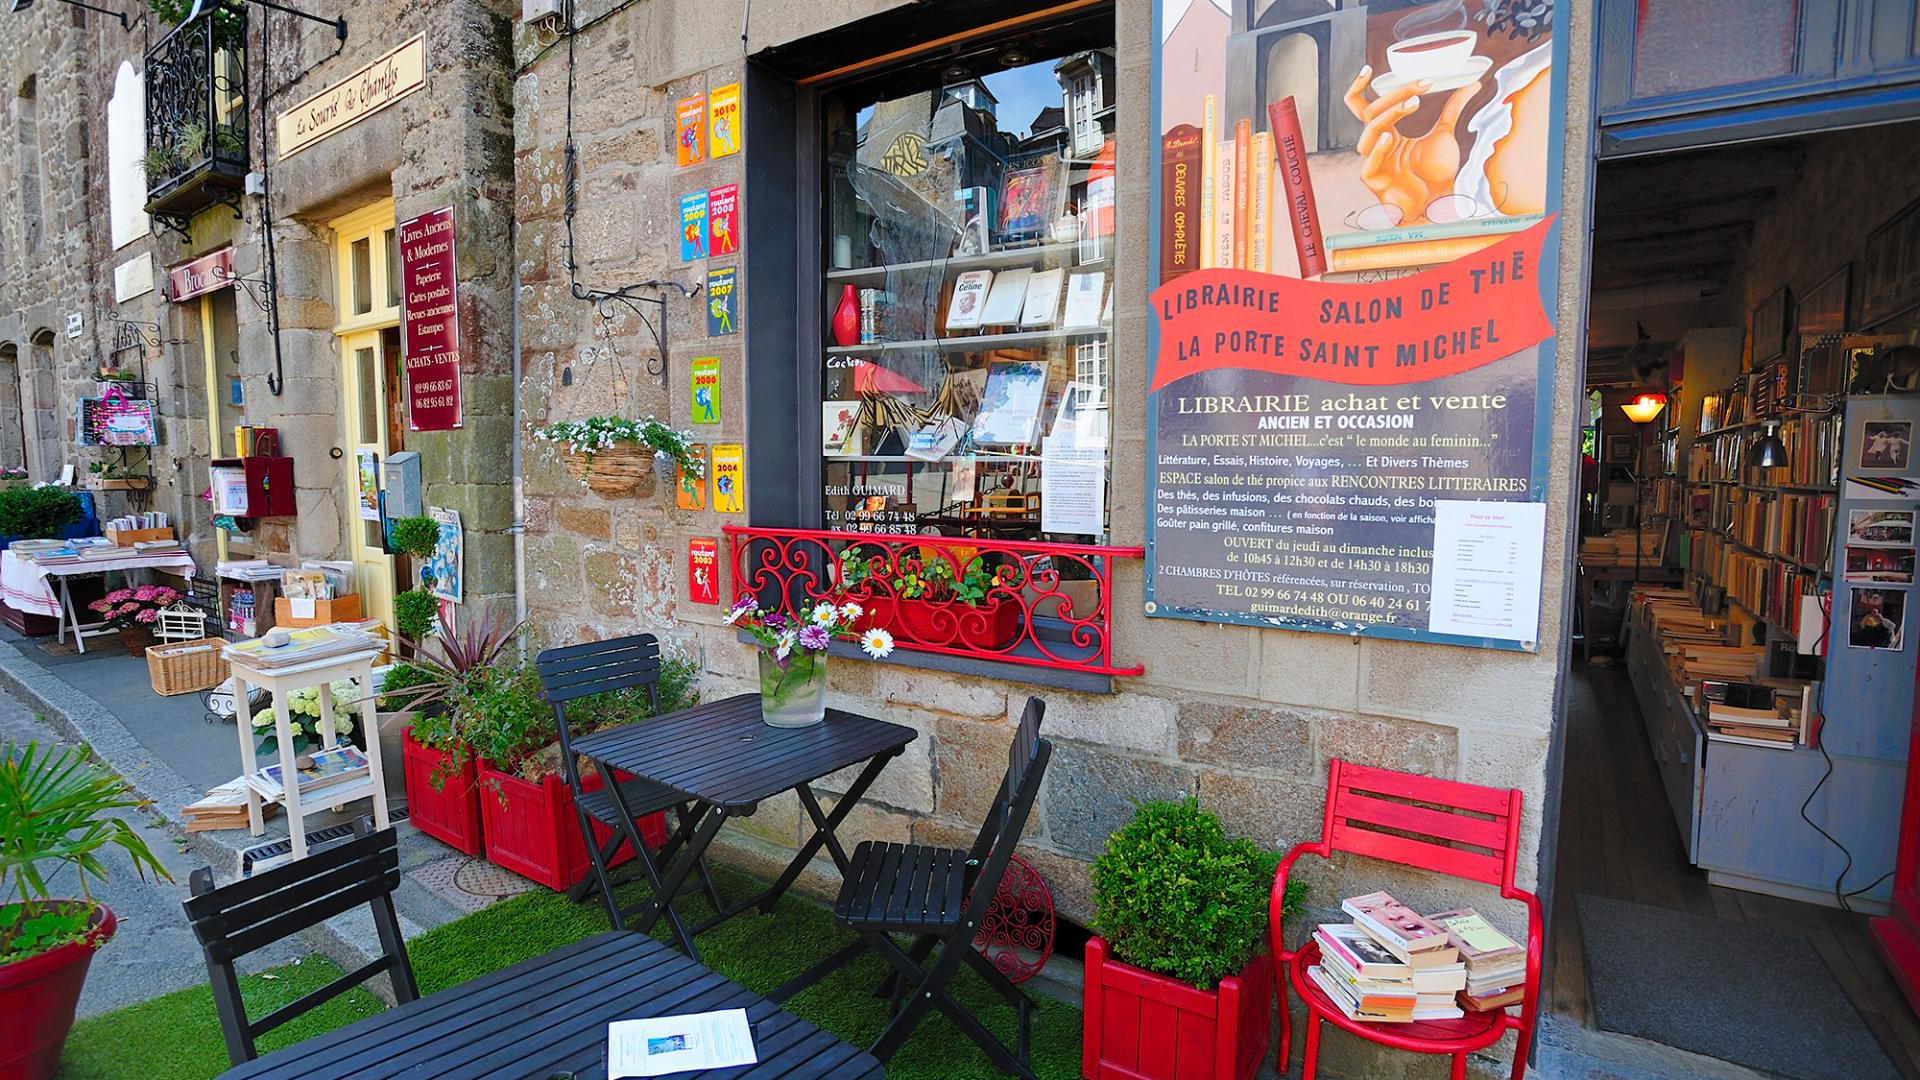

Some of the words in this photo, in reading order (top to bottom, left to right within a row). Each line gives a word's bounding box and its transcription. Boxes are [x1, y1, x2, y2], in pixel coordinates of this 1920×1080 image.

[308, 91, 340, 132] Souris
[713, 103, 736, 117] 2010
[1174, 163, 1187, 207] OEUVRES
[683, 209, 705, 222] 2009
[712, 203, 734, 216] 2008
[1222, 210, 1229, 225] ET
[1295, 190, 1313, 238] CHEVAL
[403, 229, 423, 244] Livres
[424, 219, 452, 237] Anciens
[407, 249, 413, 263] &
[415, 242, 449, 260] Modernes
[1305, 242, 1317, 258] LE
[416, 268, 441, 286] Papeterie
[709, 276, 733, 288] routard
[410, 292, 427, 304] Cartes
[428, 285, 450, 302] postales
[710, 285, 733, 297] 2007
[407, 309, 426, 321] Revues
[427, 303, 454, 318] anciennes
[1164, 283, 1279, 320] LIBRAIRIE
[1319, 296, 1402, 324] SALON
[1421, 282, 1450, 310] DE
[418, 323, 444, 335] Estampes
[1178, 335, 1200, 361] LA
[1215, 330, 1285, 357] PORTE
[1299, 338, 1379, 368] SAINT
[1396, 319, 1500, 368] MICHEL
[407, 355, 431, 369] ACHATS
[435, 351, 460, 365] VENTES
[694, 368, 717, 376] routard
[695, 376, 717, 385] 2006
[1178, 394, 1310, 414] LIBRAIRIE
[1321, 393, 1388, 411] achat
[1396, 395, 1421, 410] et
[1429, 394, 1506, 410] vente
[1258, 415, 1310, 430] ANCIEN
[1314, 415, 1333, 429] ET
[1337, 414, 1414, 429] OCCASION
[1182, 434, 1198, 446] LA
[1200, 434, 1240, 446] PORTE
[1241, 434, 1257, 446] ST
[1356, 435, 1367, 447] le
[1369, 434, 1409, 447] monde
[1412, 437, 1427, 447] au
[717, 464, 738, 472] 2004
[1158, 454, 1210, 467] Littérature,
[1213, 455, 1247, 467] Essais,
[1249, 455, 1292, 467] Histoire,
[1295, 456, 1344, 468] Voyages,
[1366, 456, 1378, 467] Et
[1381, 456, 1418, 468] Divers
[1421, 456, 1469, 468] Thèmes
[825, 485, 850, 496] Edith
[852, 485, 905, 496] GUIMARD
[1159, 471, 1202, 485] ESPACE
[1204, 473, 1229, 485] salon
[1232, 474, 1244, 485] de
[1247, 474, 1263, 486] thé
[1266, 475, 1305, 488] propice
[1308, 479, 1329, 487] aux
[1331, 475, 1425, 490] RENCONTRES
[1428, 477, 1527, 492] LITTERAIRES
[1157, 489, 1175, 500] Des
[1177, 489, 1200, 501] thés,
[1202, 491, 1220, 501] des
[1222, 491, 1270, 504] infusions,
[1273, 493, 1292, 504] des
[1295, 493, 1346, 505] chocolats
[1349, 495, 1391, 508] chauds,
[1394, 496, 1415, 508] des
[825, 510, 839, 520] Tél
[845, 511, 856, 520] 02
[859, 511, 871, 521] 99
[873, 511, 885, 521] 66
[888, 511, 899, 521] 74
[903, 511, 915, 522] 48
[1157, 503, 1174, 514] Des
[1176, 504, 1228, 516] pâtisseries
[1230, 507, 1265, 517] maison
[1304, 511, 1336, 520] fonction
[1337, 513, 1348, 521] de
[1350, 513, 1357, 521] la
[1359, 514, 1388, 523] saison,
[1391, 515, 1407, 523] voir
[846, 523, 858, 533] 02
[859, 523, 872, 534] 99
[874, 524, 886, 534] 66
[889, 524, 901, 534] 85
[904, 524, 917, 535] 48
[1157, 517, 1187, 528] Goûter
[1189, 520, 1210, 531] pain
[1212, 520, 1240, 533] grillé,
[1242, 521, 1293, 533] confitures
[1296, 524, 1334, 535] maison
[691, 549, 715, 558] routard
[1223, 536, 1274, 549] OUVERT
[1276, 540, 1290, 550] du
[1292, 540, 1320, 553] jeudi
[1322, 544, 1336, 553] au
[1339, 542, 1395, 556] dimanche
[1398, 545, 1434, 558] inclus
[694, 556, 713, 565] 2003
[1226, 552, 1239, 562] de
[1244, 553, 1272, 564] 10h45
[1274, 554, 1280, 565] à
[1284, 555, 1315, 567] 12h30
[1318, 559, 1328, 569] et
[1330, 558, 1345, 569] de
[1348, 559, 1381, 571] 14h30
[1384, 561, 1391, 572] à
[1394, 561, 1430, 574] 18h30
[1159, 565, 1164, 575] 2
[1165, 566, 1222, 579] CHAMBRES
[1224, 569, 1271, 583] D'HÔTES
[1272, 573, 1328, 587] référencées,
[1330, 579, 1346, 588] sur
[1216, 584, 1242, 597] TEL
[1245, 587, 1258, 598] 02
[1261, 588, 1275, 599] 99
[1277, 589, 1291, 600] 66
[1293, 590, 1307, 601] 74
[1310, 592, 1324, 603] 48
[1327, 593, 1349, 605] OU
[1352, 595, 1367, 607] 06
[1370, 596, 1385, 608] 40
[1388, 598, 1403, 610] 24
[1406, 600, 1420, 611] 61
[1251, 602, 1397, 624] guimardedith@orange.fr
